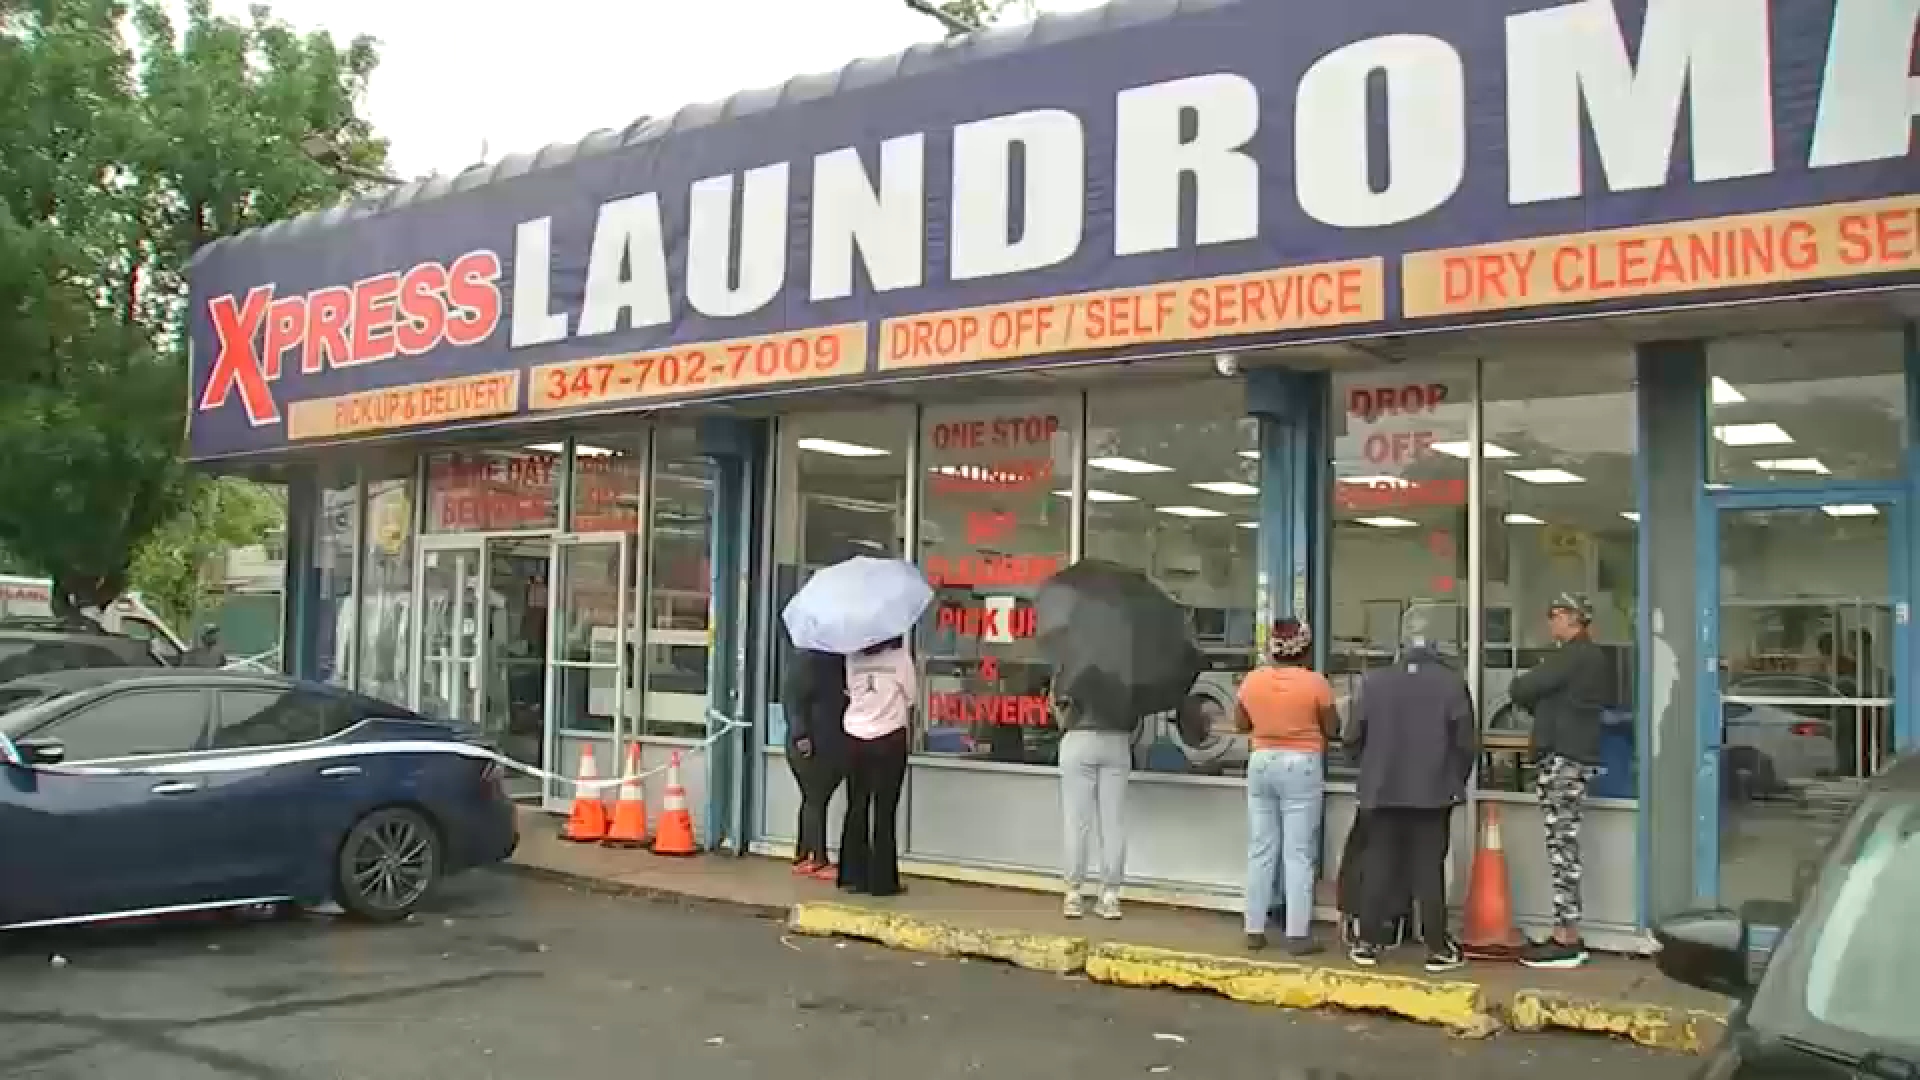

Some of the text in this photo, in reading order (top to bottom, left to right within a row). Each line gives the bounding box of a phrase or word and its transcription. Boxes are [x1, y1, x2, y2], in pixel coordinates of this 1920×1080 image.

[1442, 209, 1920, 305] DRY CLEANING SE
[890, 268, 1362, 361] DROP OFF / SELF SERVICE
[200, 249, 502, 426] XPRESS
[546, 335, 842, 402] 347-702-7009
[421, 375, 513, 417] DELIVERY
[1350, 384, 1449, 417] DROP
[933, 414, 1060, 451] ONE STOP
[1363, 431, 1434, 464] OFF
[936, 606, 998, 638] PICK
[928, 692, 1054, 726] DELIVERY
